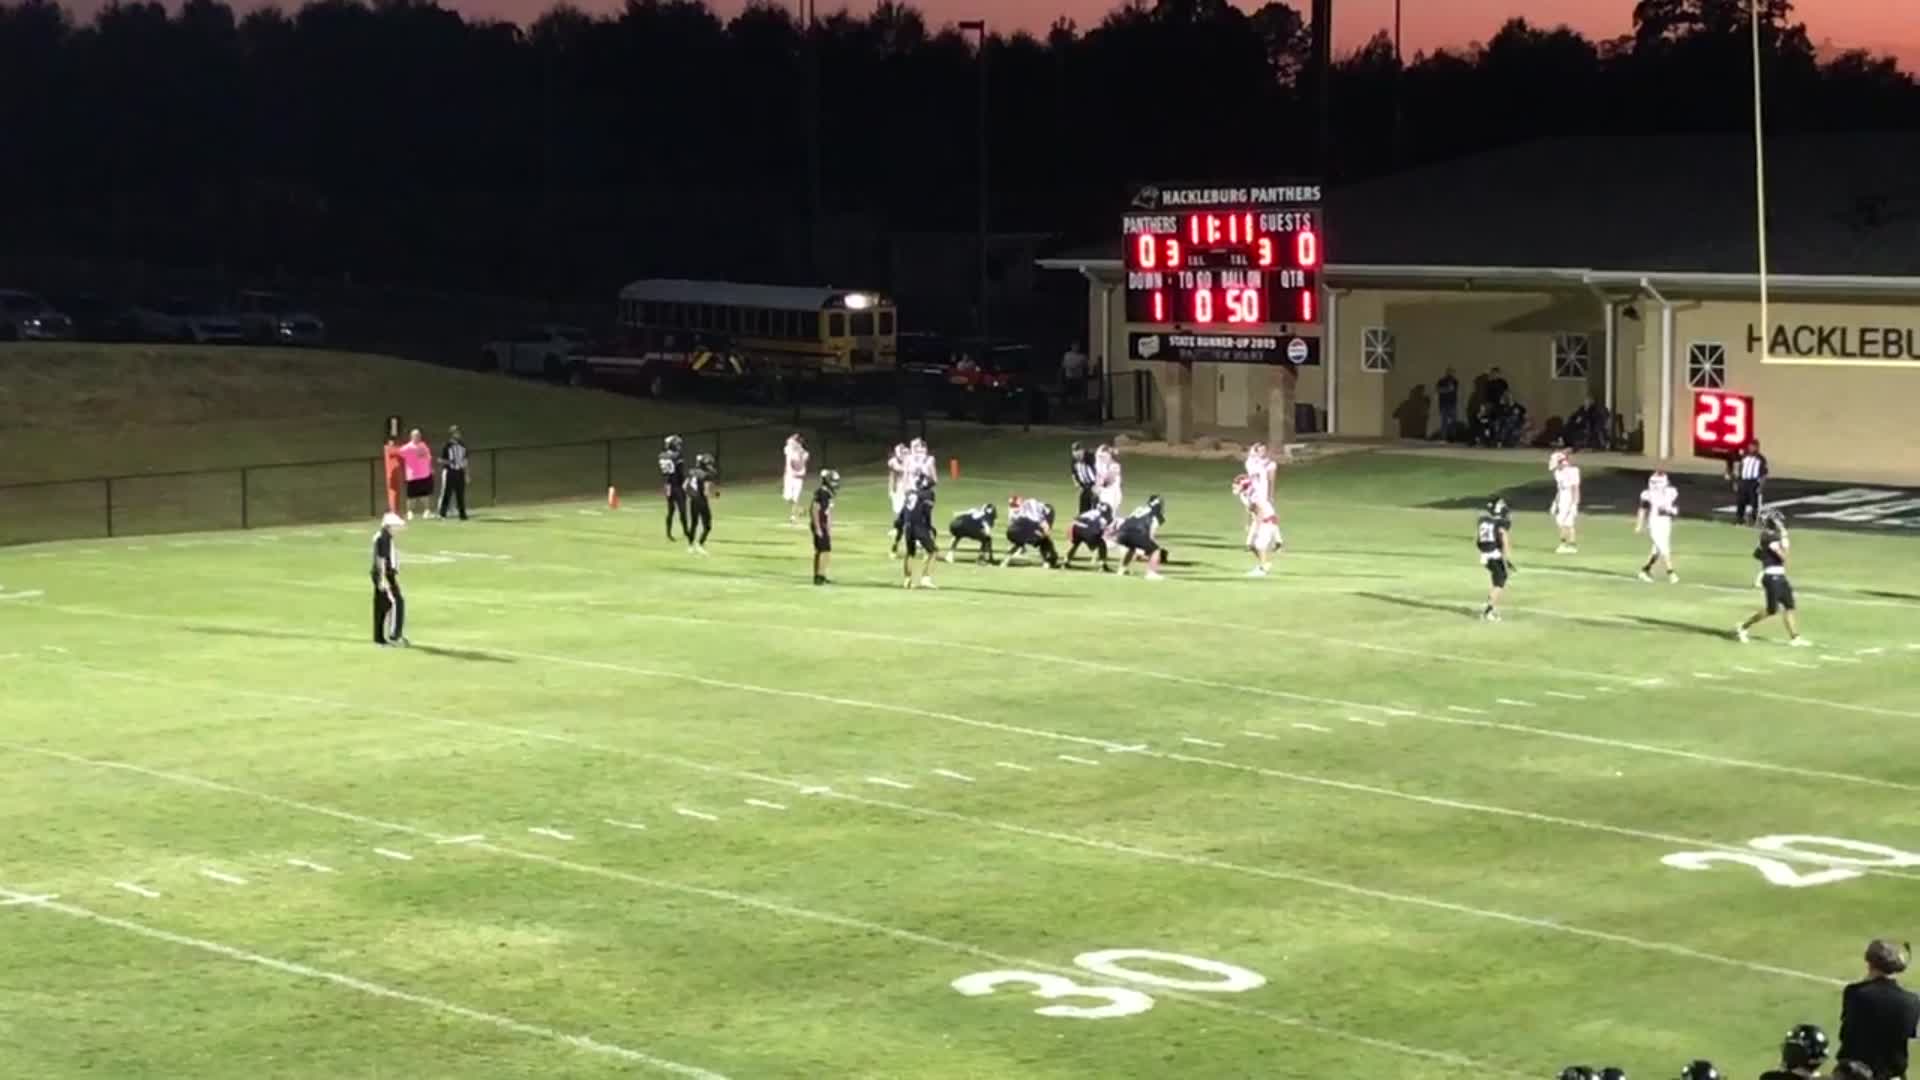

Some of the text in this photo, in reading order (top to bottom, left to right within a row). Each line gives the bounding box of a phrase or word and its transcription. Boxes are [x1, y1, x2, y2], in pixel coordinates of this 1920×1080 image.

[1162, 185, 1321, 205] HACKLEBURG PANTHERS
[1123, 215, 1177, 234] PANTHERS
[1191, 213, 1254, 244] 11:11
[1260, 213, 1311, 232] GUESTS
[1139, 234, 1155, 268] 0
[1165, 239, 1179, 266] 3
[1258, 238, 1271, 265] 3
[1298, 232, 1315, 265] 0
[1128, 271, 1163, 290] DOWN
[1178, 270, 1212, 289] TO GO
[1280, 270, 1304, 288] QTR
[1154, 291, 1163, 321] 1
[1195, 288, 1213, 323] 0
[1226, 288, 1259, 323] 50
[1303, 290, 1311, 321] 1
[1696, 394, 1746, 444] 23
[1479, 521, 1495, 542] 21
[1660, 834, 1920, 888] 20
[951, 948, 1267, 1018] 30
